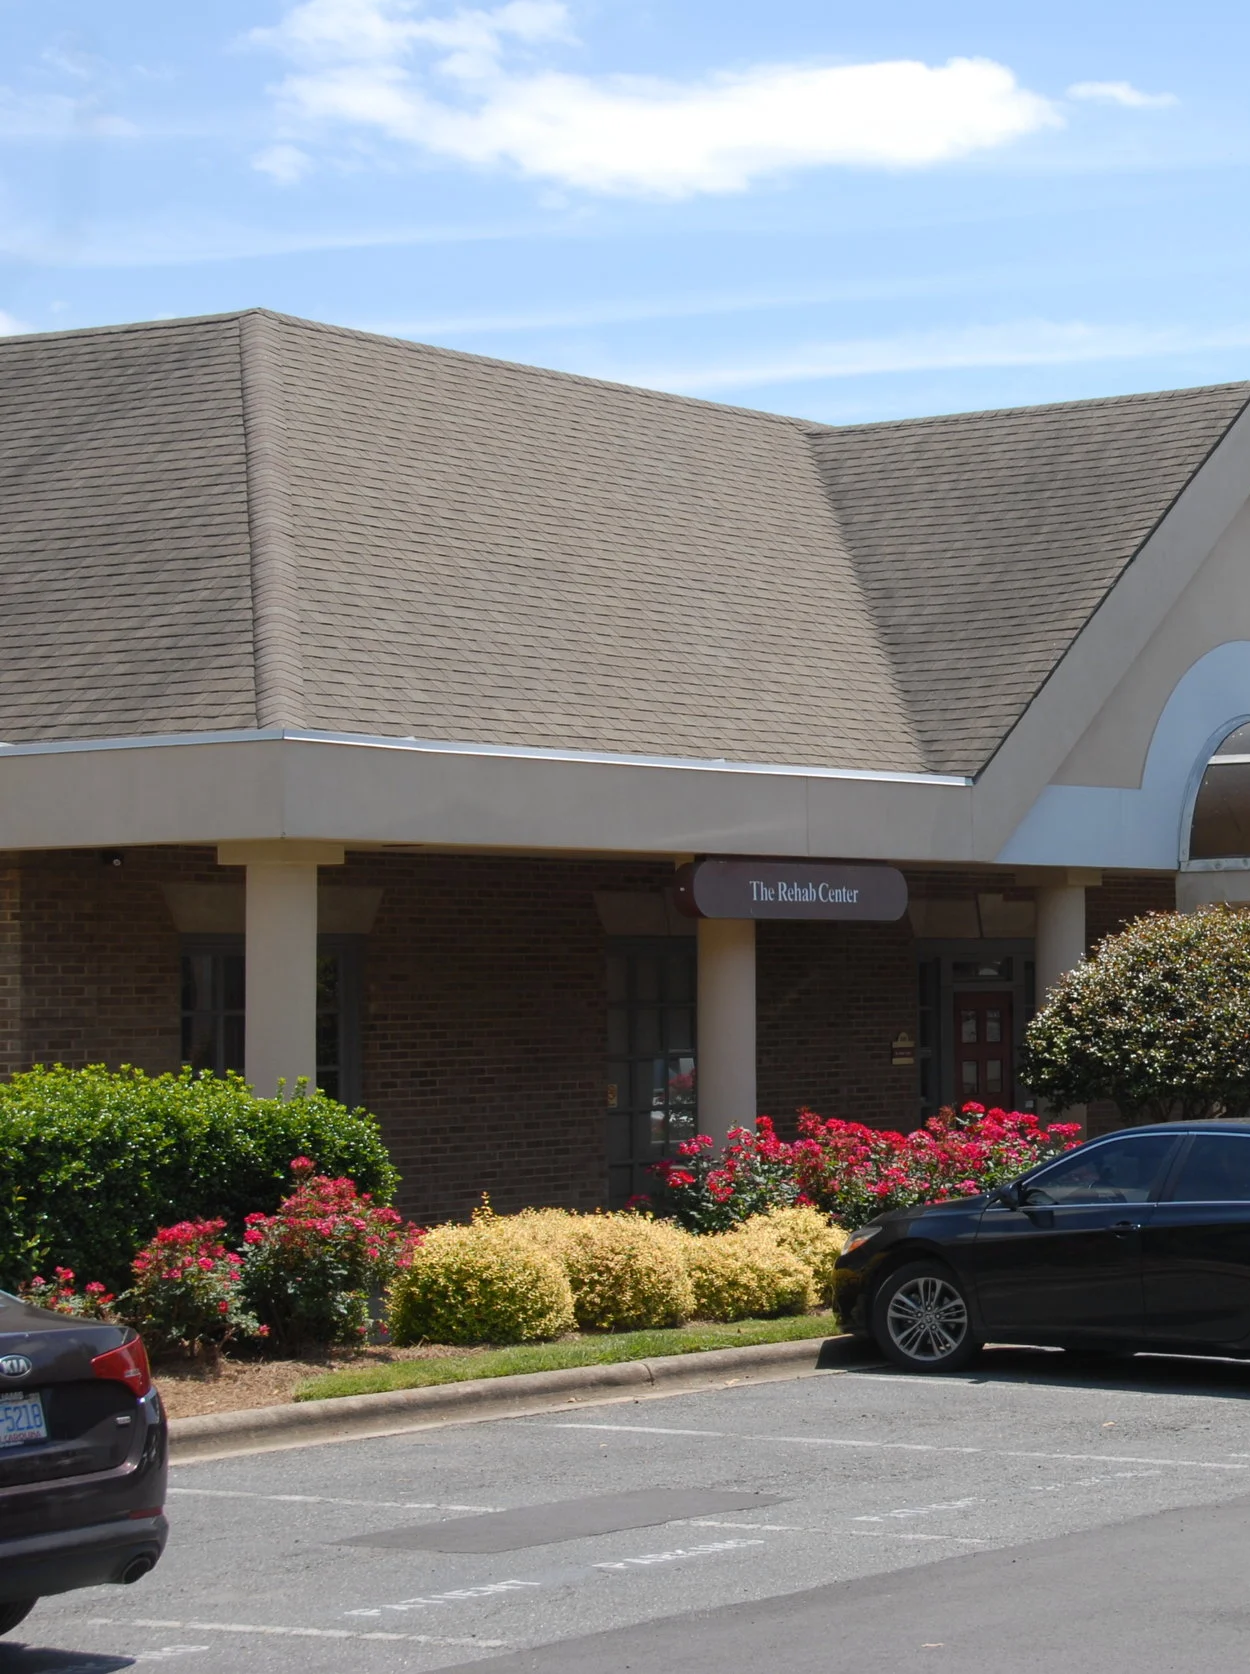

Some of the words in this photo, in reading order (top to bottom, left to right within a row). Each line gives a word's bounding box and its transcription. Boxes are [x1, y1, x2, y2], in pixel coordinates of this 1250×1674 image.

[749, 880, 775, 902] The
[777, 881, 817, 903] Rehab
[818, 882, 859, 904] Center
[2, 1358, 28, 1375] KIA
